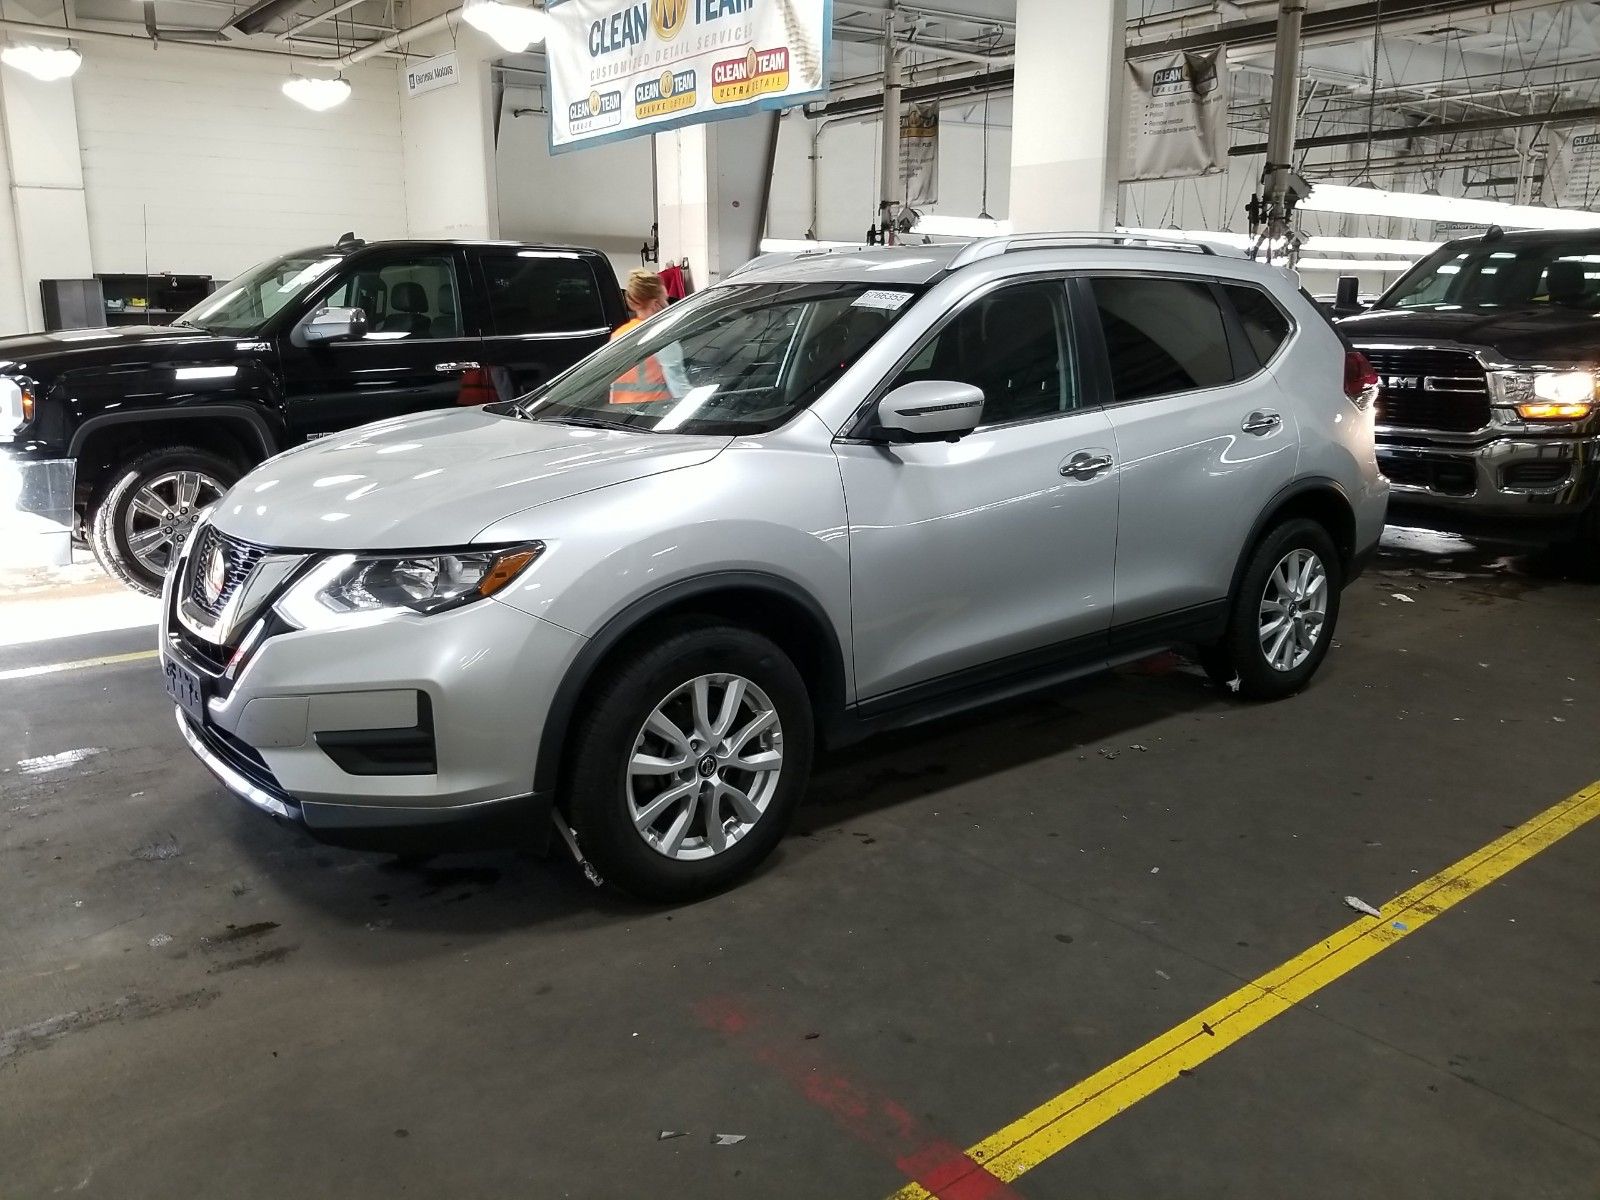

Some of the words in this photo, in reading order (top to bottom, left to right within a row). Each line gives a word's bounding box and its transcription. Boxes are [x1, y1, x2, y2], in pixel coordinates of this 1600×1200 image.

[588, 3, 648, 58] CLEAN
[695, 0, 754, 25] TE
[590, 53, 649, 82] CUSTOMIZED
[656, 42, 690, 63] DETAIL
[714, 62, 747, 84] CLEAN
[757, 51, 785, 73] TEAM
[1154, 68, 1182, 84] CLEAN
[636, 82, 659, 103] CLEAN
[674, 73, 694, 93] TEAM
[719, 84, 750, 98] ULTRA
[569, 102, 590, 120] CLEAN
[601, 93, 620, 112] TEAM
